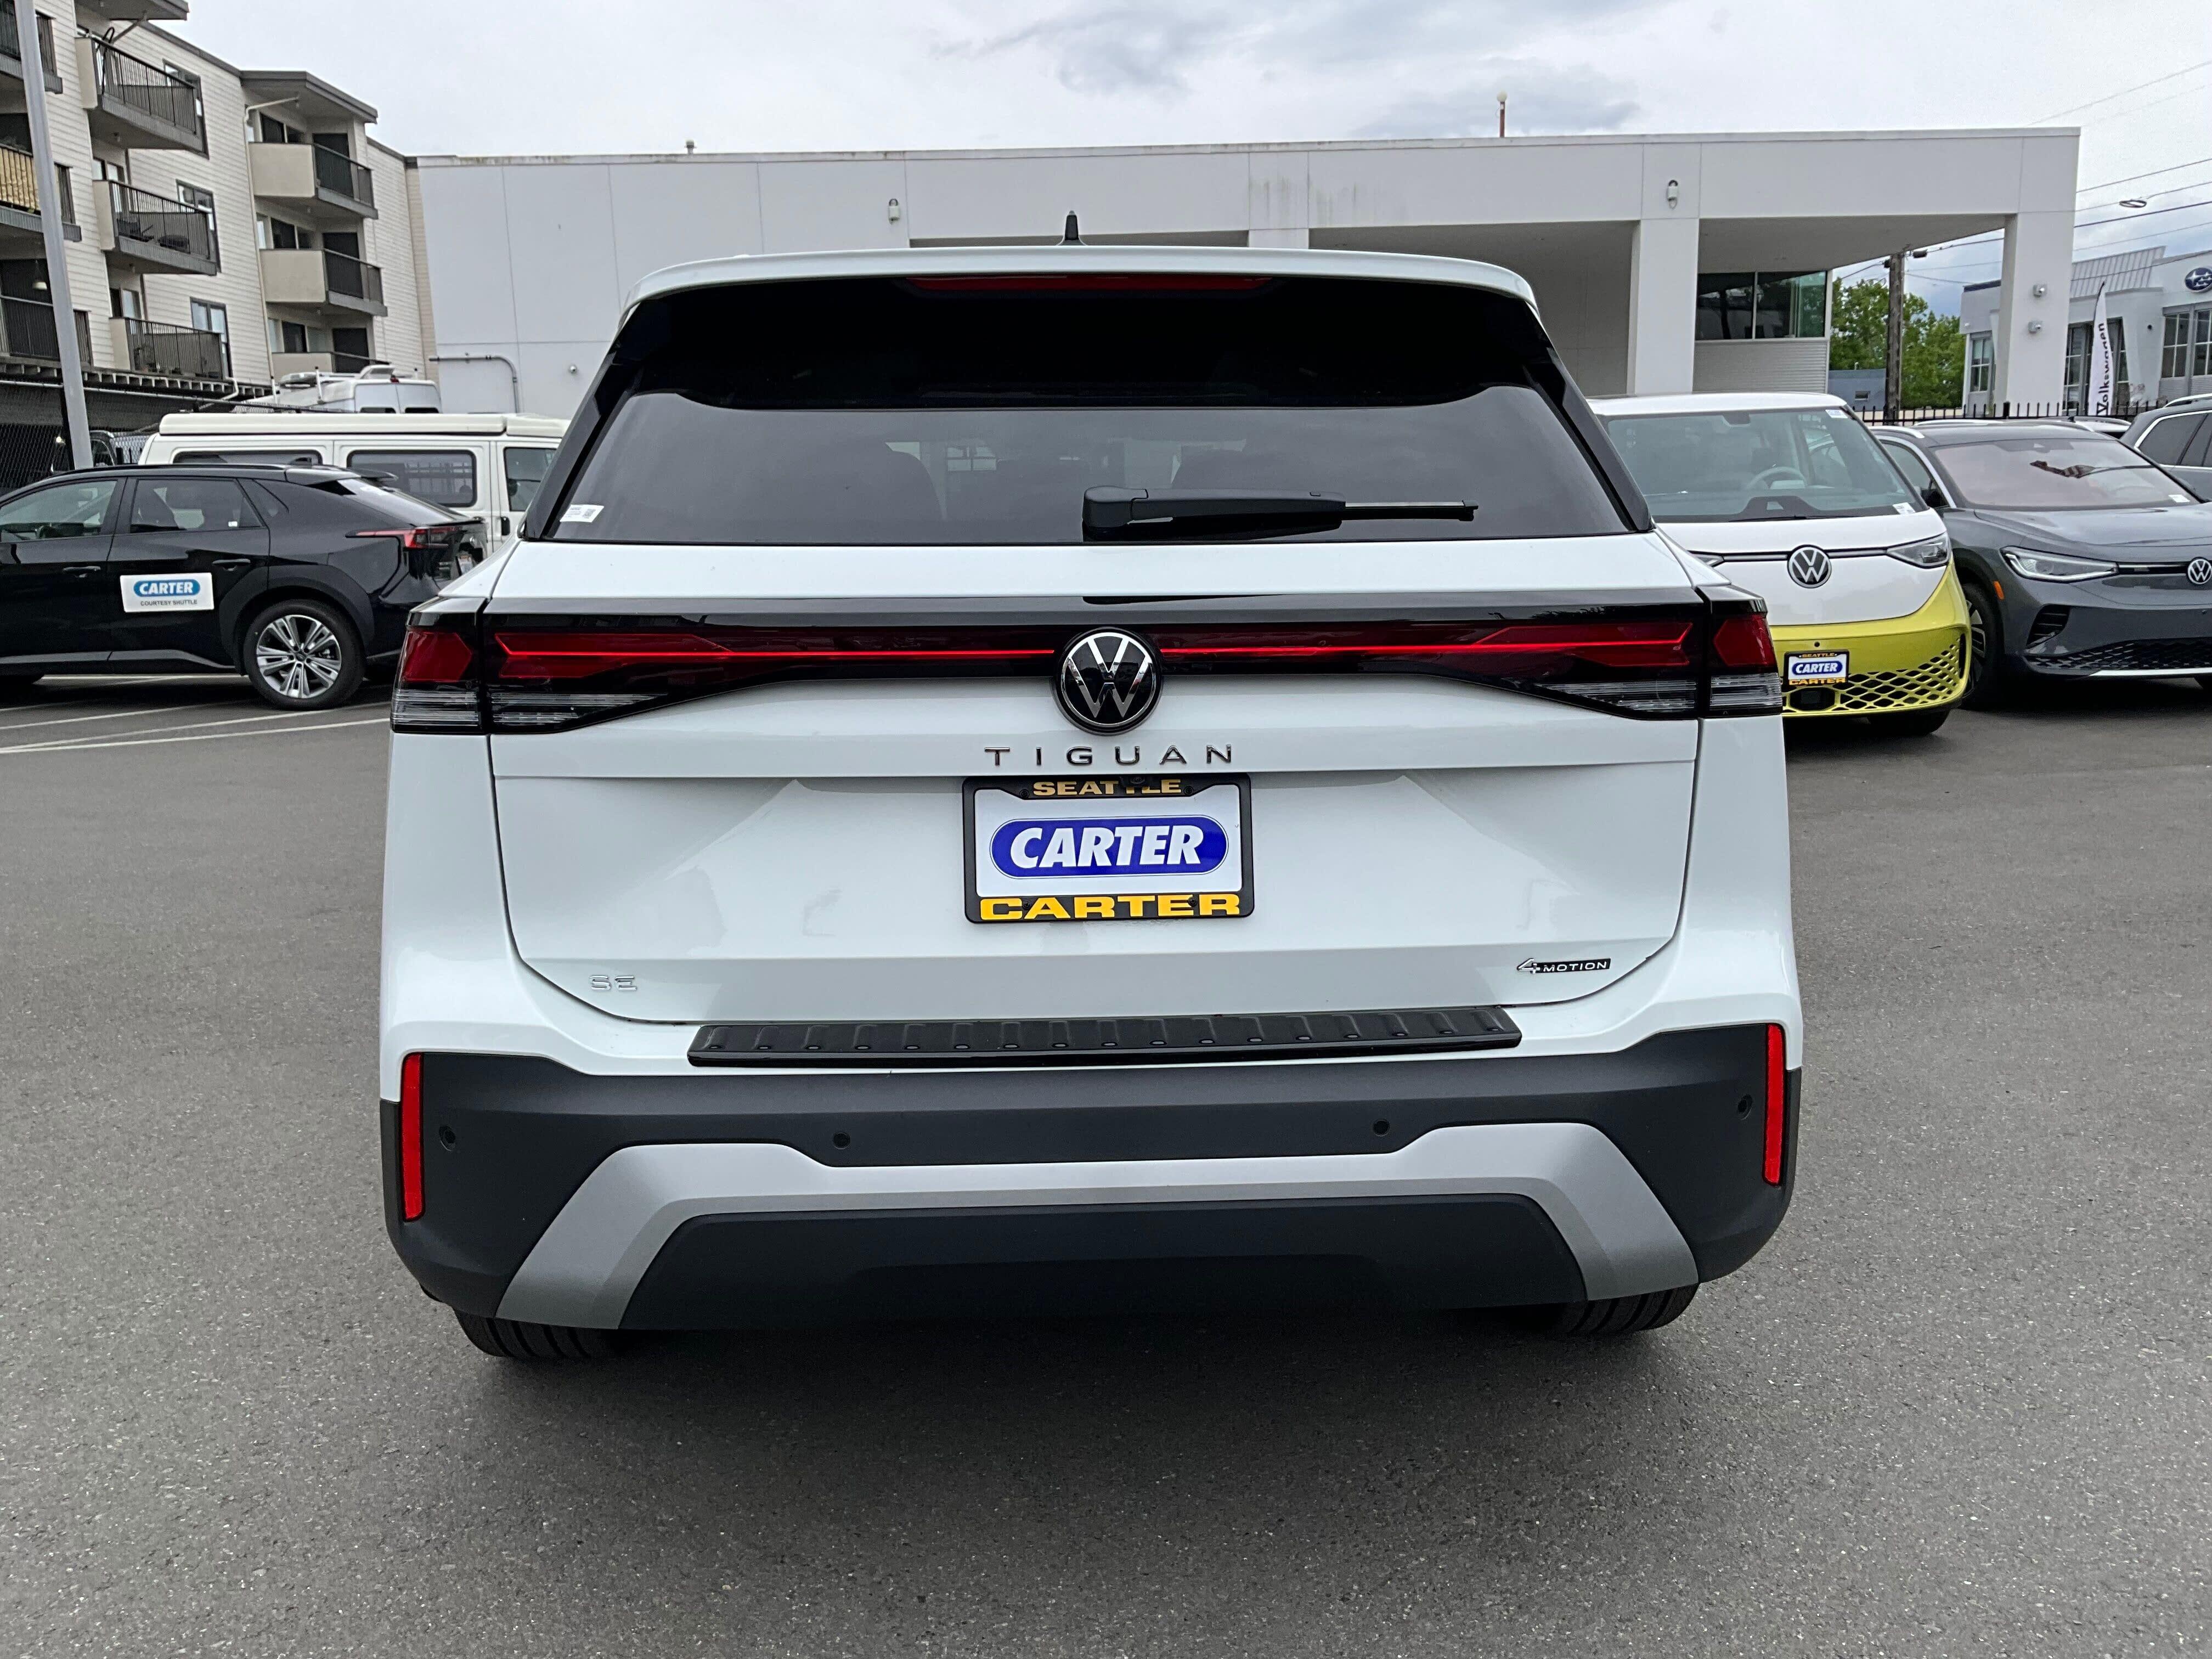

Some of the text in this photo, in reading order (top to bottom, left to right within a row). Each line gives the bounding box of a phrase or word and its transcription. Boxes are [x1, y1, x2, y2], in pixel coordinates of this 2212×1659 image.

[139, 582, 193, 595] CARTER
[1796, 662, 1838, 674] CARTER
[985, 744, 1232, 766] TIGUAN
[1010, 825, 1204, 869] CARTER
[980, 893, 1240, 921] CARTER
[589, 975, 637, 991] SE
